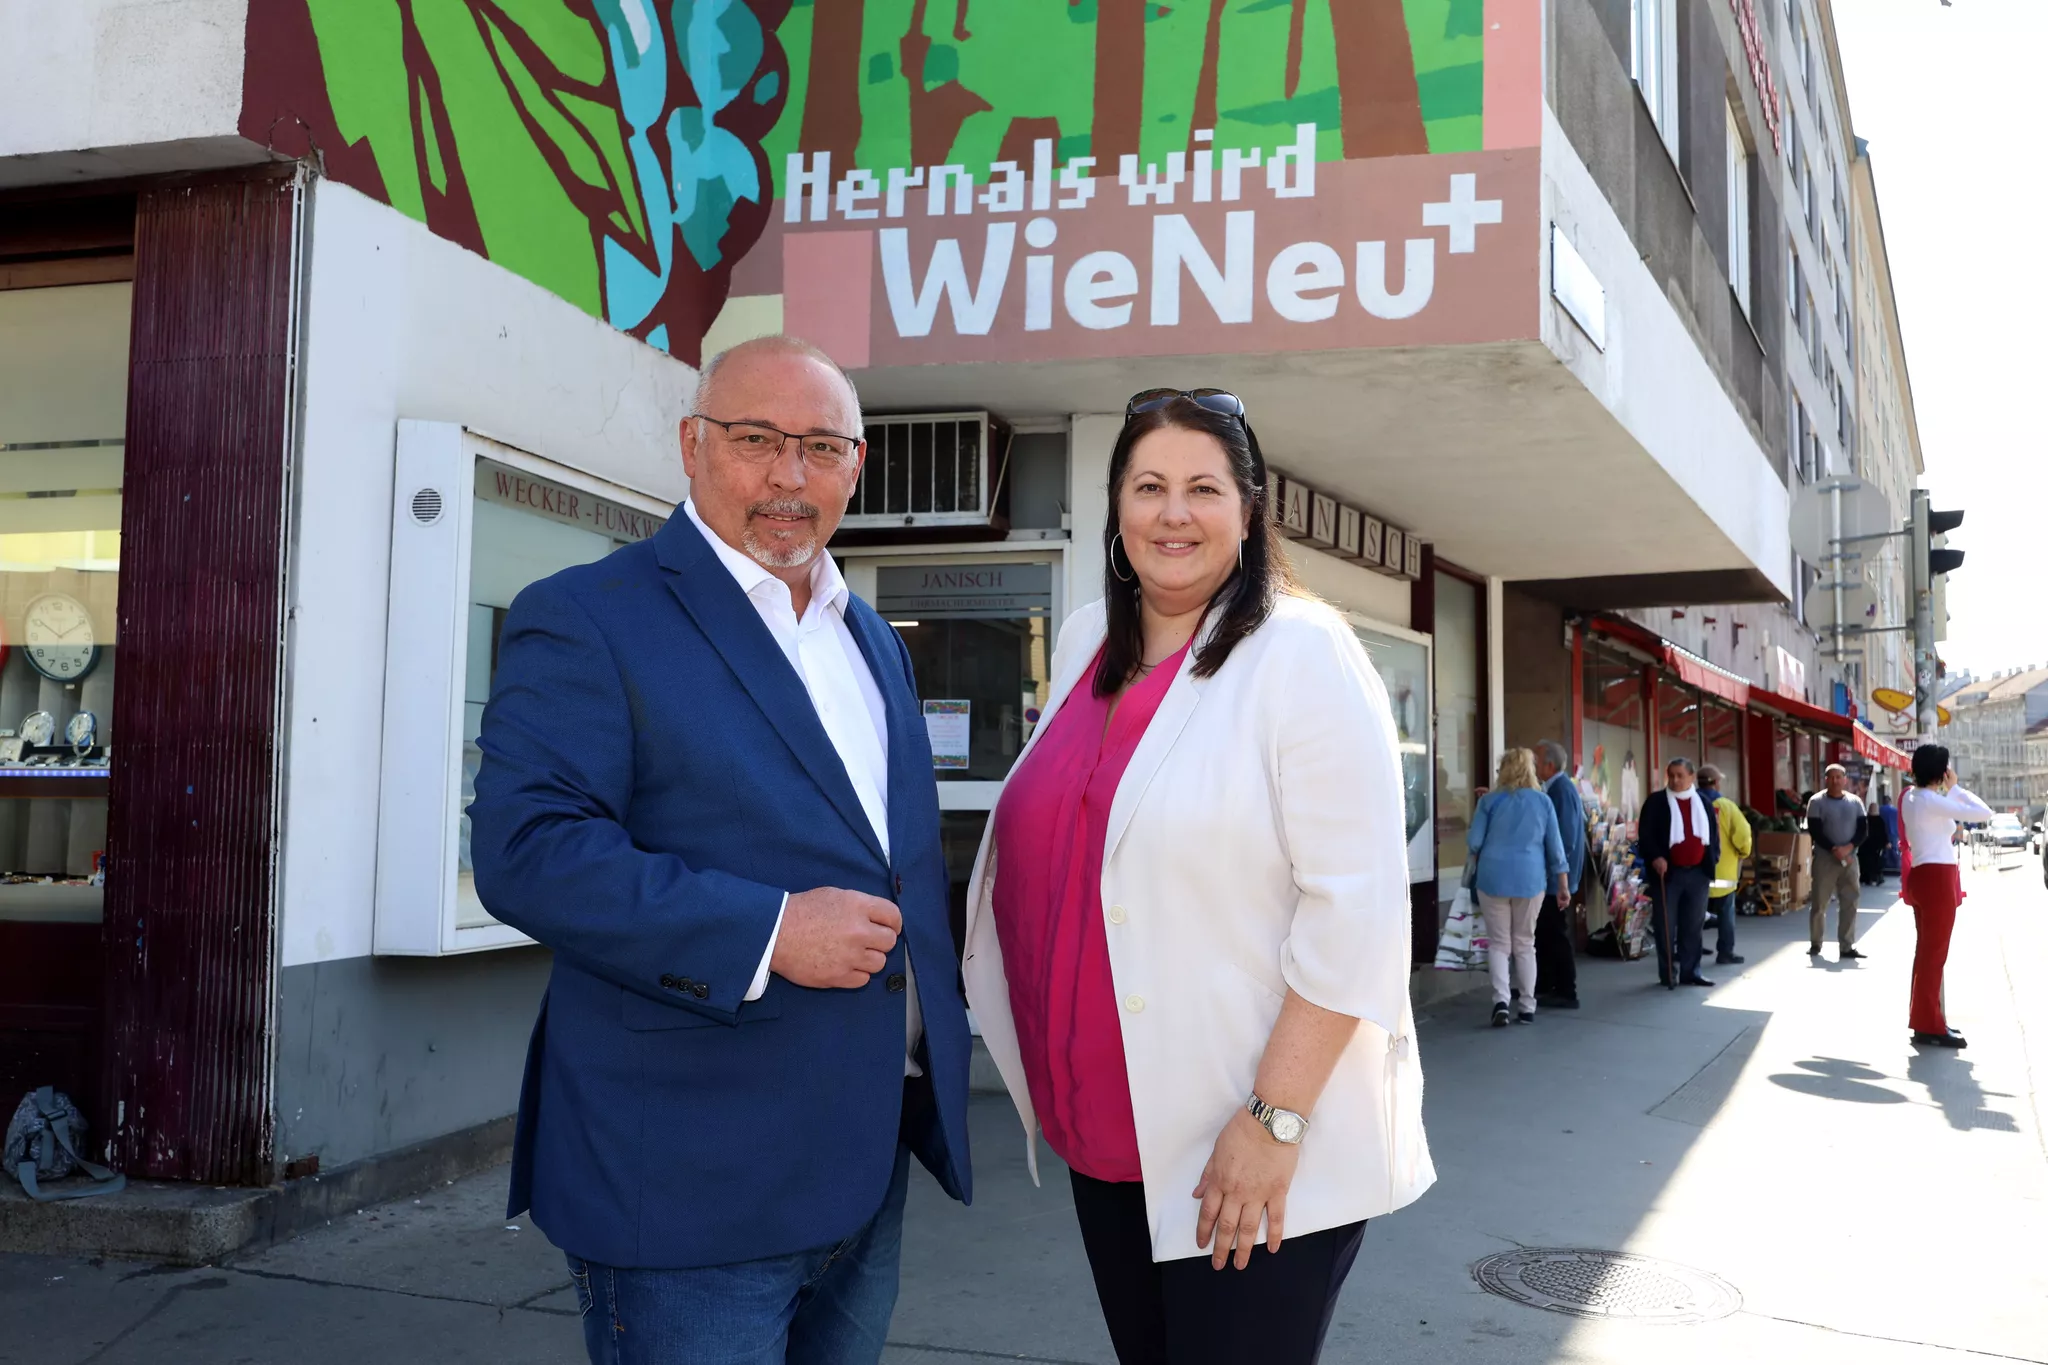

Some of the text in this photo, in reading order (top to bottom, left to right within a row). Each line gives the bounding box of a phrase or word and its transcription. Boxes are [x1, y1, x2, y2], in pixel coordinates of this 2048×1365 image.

[783, 122, 1316, 222] Hernals wird
[495, 470, 580, 520] WECKER
[1268, 488, 1418, 575] ANISCH
[921, 571, 1003, 589] JANISCH
[36, 648, 44, 658] 8
[82, 647, 90, 655] 4
[47, 658, 56, 668] 7
[60, 662, 69, 671] 6
[74, 658, 82, 667] 5
